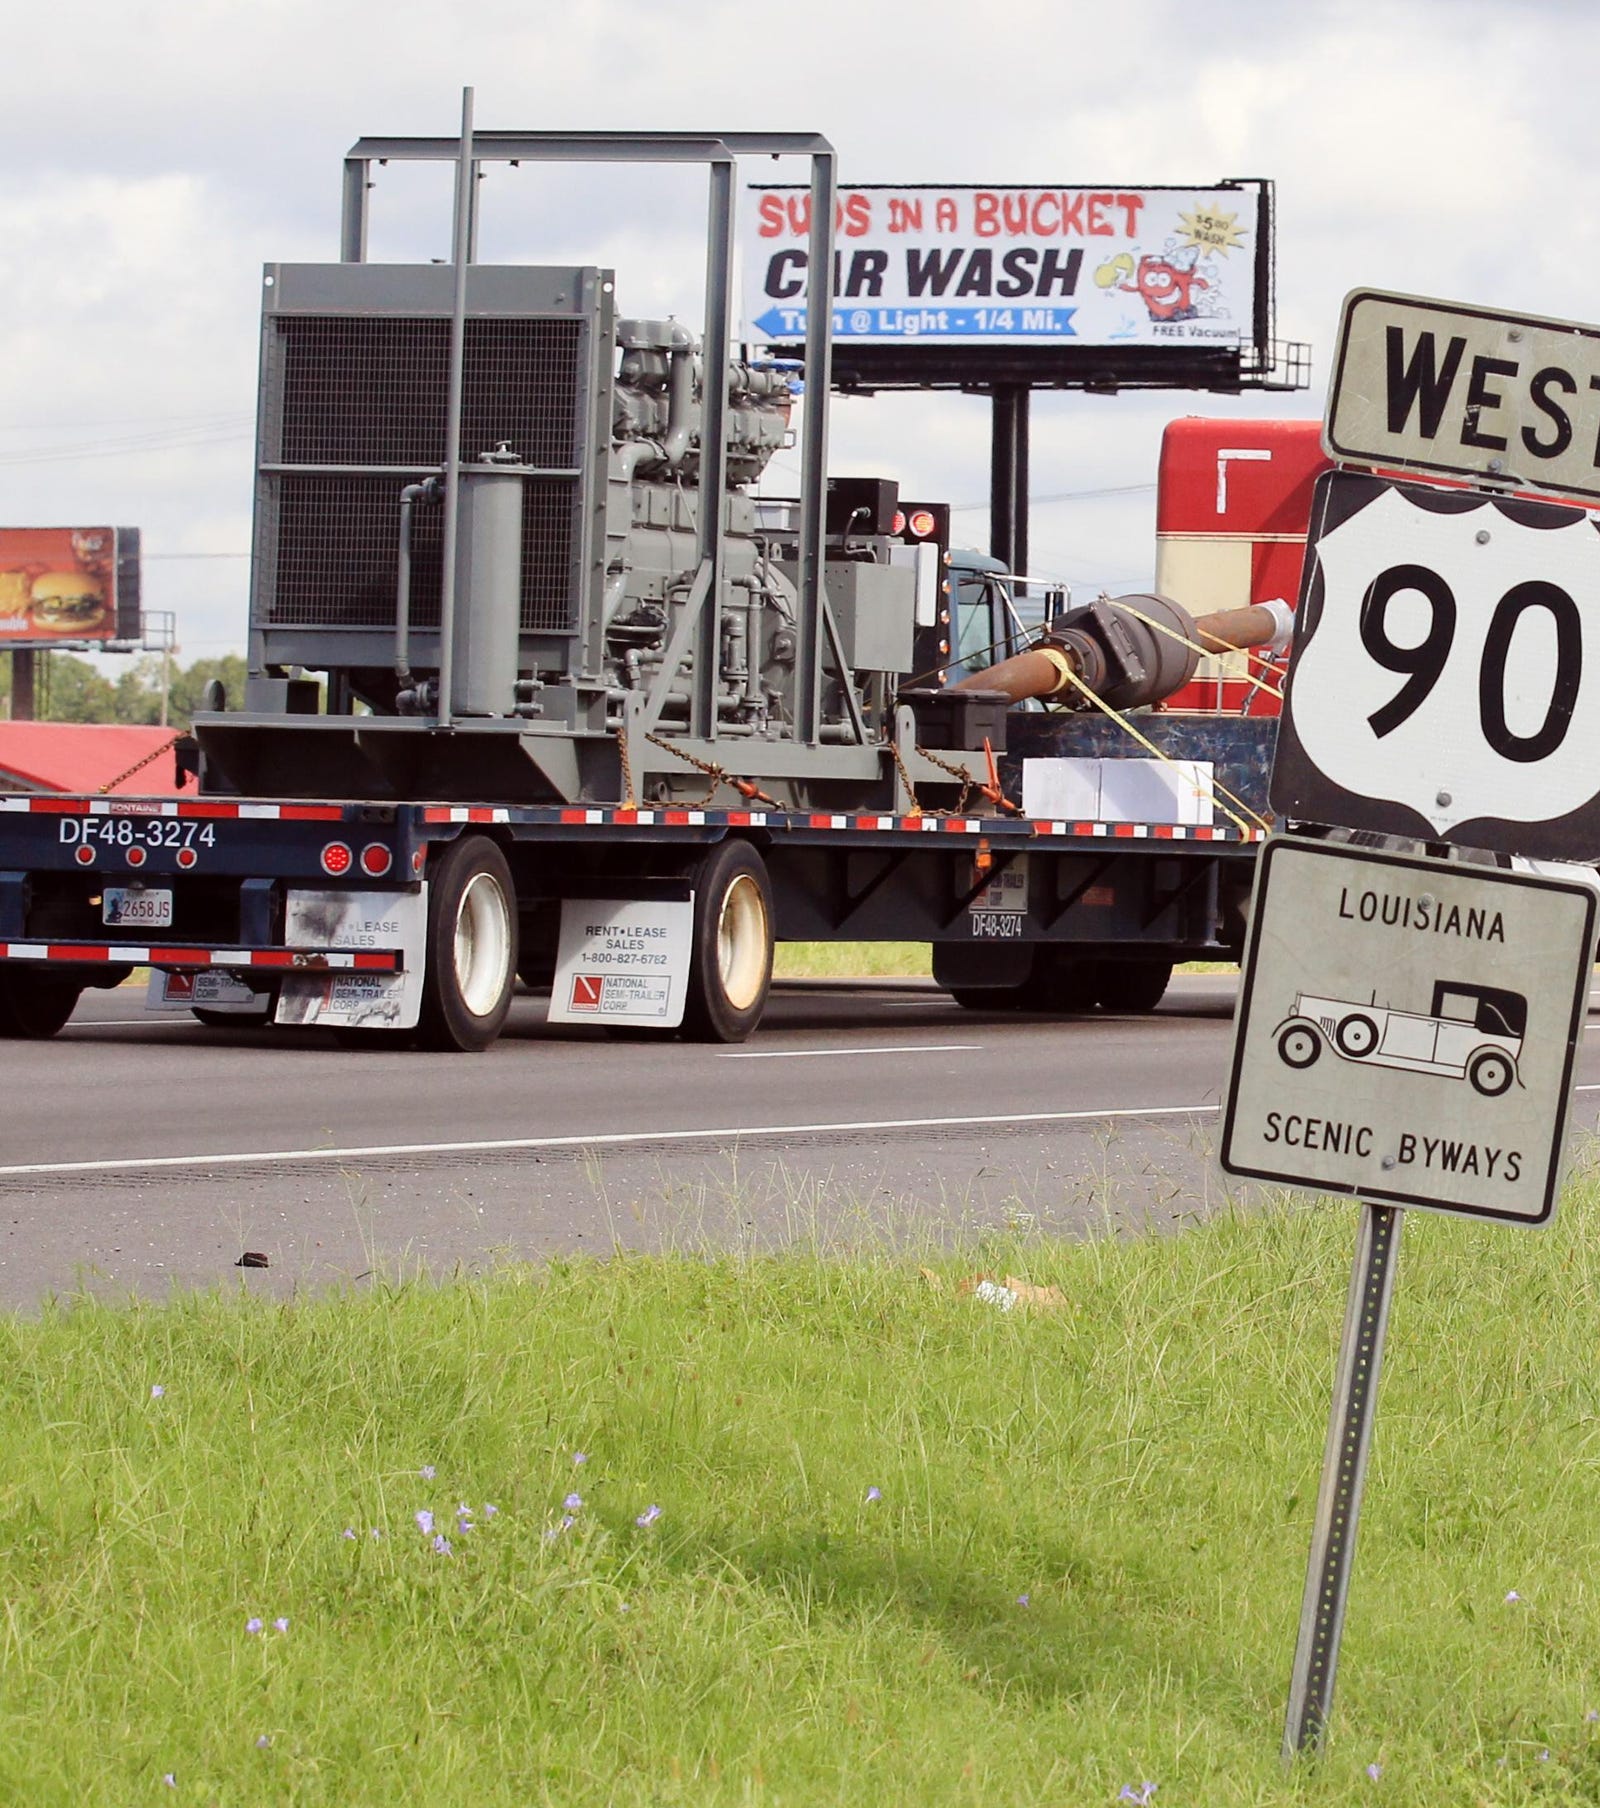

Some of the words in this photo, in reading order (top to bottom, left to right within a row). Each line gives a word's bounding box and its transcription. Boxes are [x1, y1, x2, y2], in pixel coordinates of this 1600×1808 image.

[758, 193, 872, 238] SUS
[888, 198, 922, 233] IN
[936, 197, 958, 234] A
[974, 192, 1144, 238] BUCKET
[764, 249, 888, 298] CR
[906, 248, 1084, 297] WASH
[780, 310, 843, 331] Tn
[851, 311, 871, 332] @
[879, 310, 948, 334] Light
[974, 311, 1014, 331] 1/4
[1022, 310, 1061, 330] Mi.
[1153, 325, 1184, 336] FREE
[1360, 563, 1582, 763] 90
[59, 818, 216, 848] DF48-3274
[972, 914, 1022, 937] DF48-3274
[1338, 887, 1506, 943] LOUISIANA
[335, 935, 376, 946] SALES
[606, 939, 645, 950] SALES
[336, 976, 382, 987] NATIONAL
[605, 978, 648, 989] NATIONAL
[1264, 1111, 1373, 1157] SCENIC
[1398, 1133, 1522, 1182] BYWAYS
